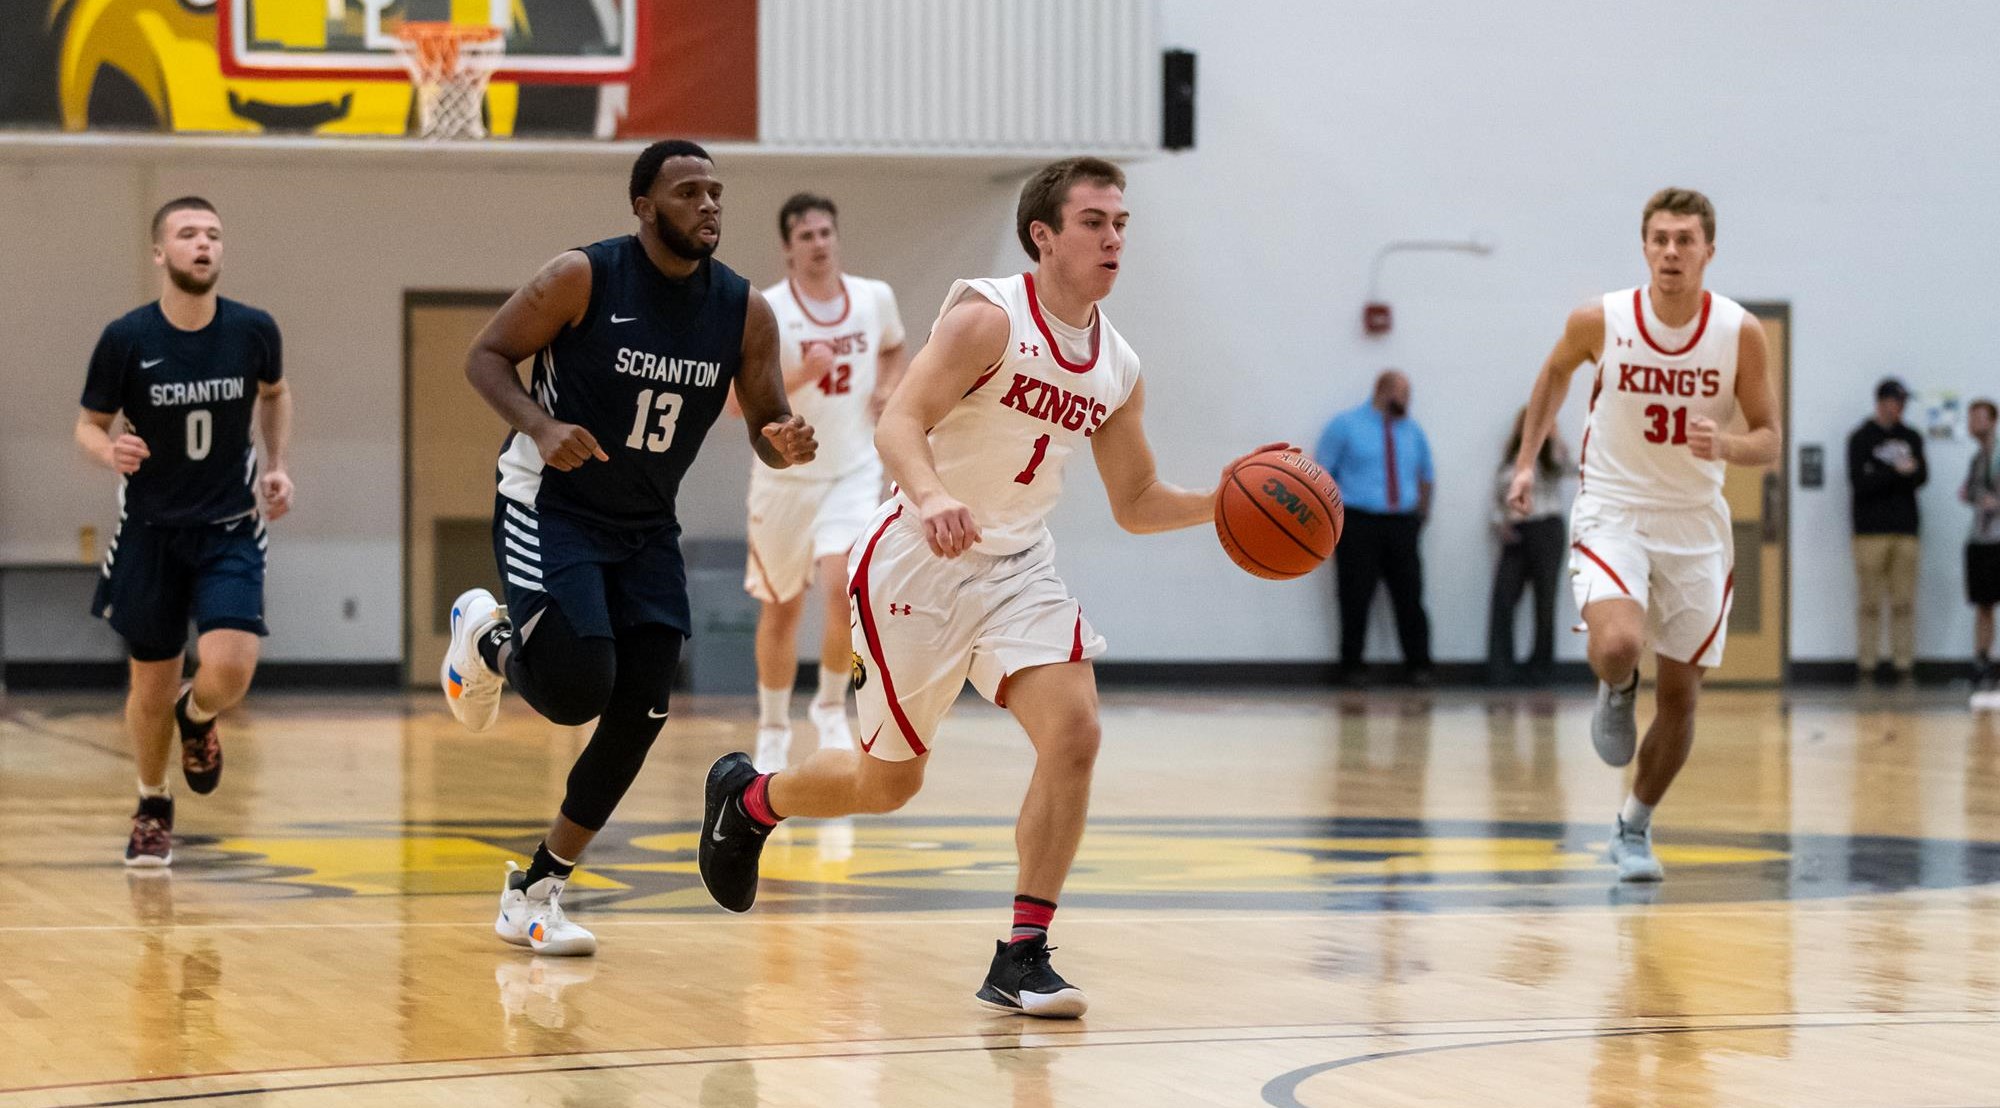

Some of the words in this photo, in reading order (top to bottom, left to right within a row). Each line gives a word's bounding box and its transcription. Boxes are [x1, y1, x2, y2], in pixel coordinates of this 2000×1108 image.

[801, 332, 868, 355] NG'S
[614, 347, 720, 387] SCRANTON
[817, 363, 851, 396] 42
[1618, 363, 1720, 397] KING'S
[150, 377, 244, 406] SCRANTON
[1000, 373, 1107, 437] KING'S
[186, 409, 213, 461] 0
[626, 388, 684, 453] 13
[1643, 403, 1688, 445] 31
[1013, 433, 1050, 485] 1
[1262, 477, 1314, 526] MAC
